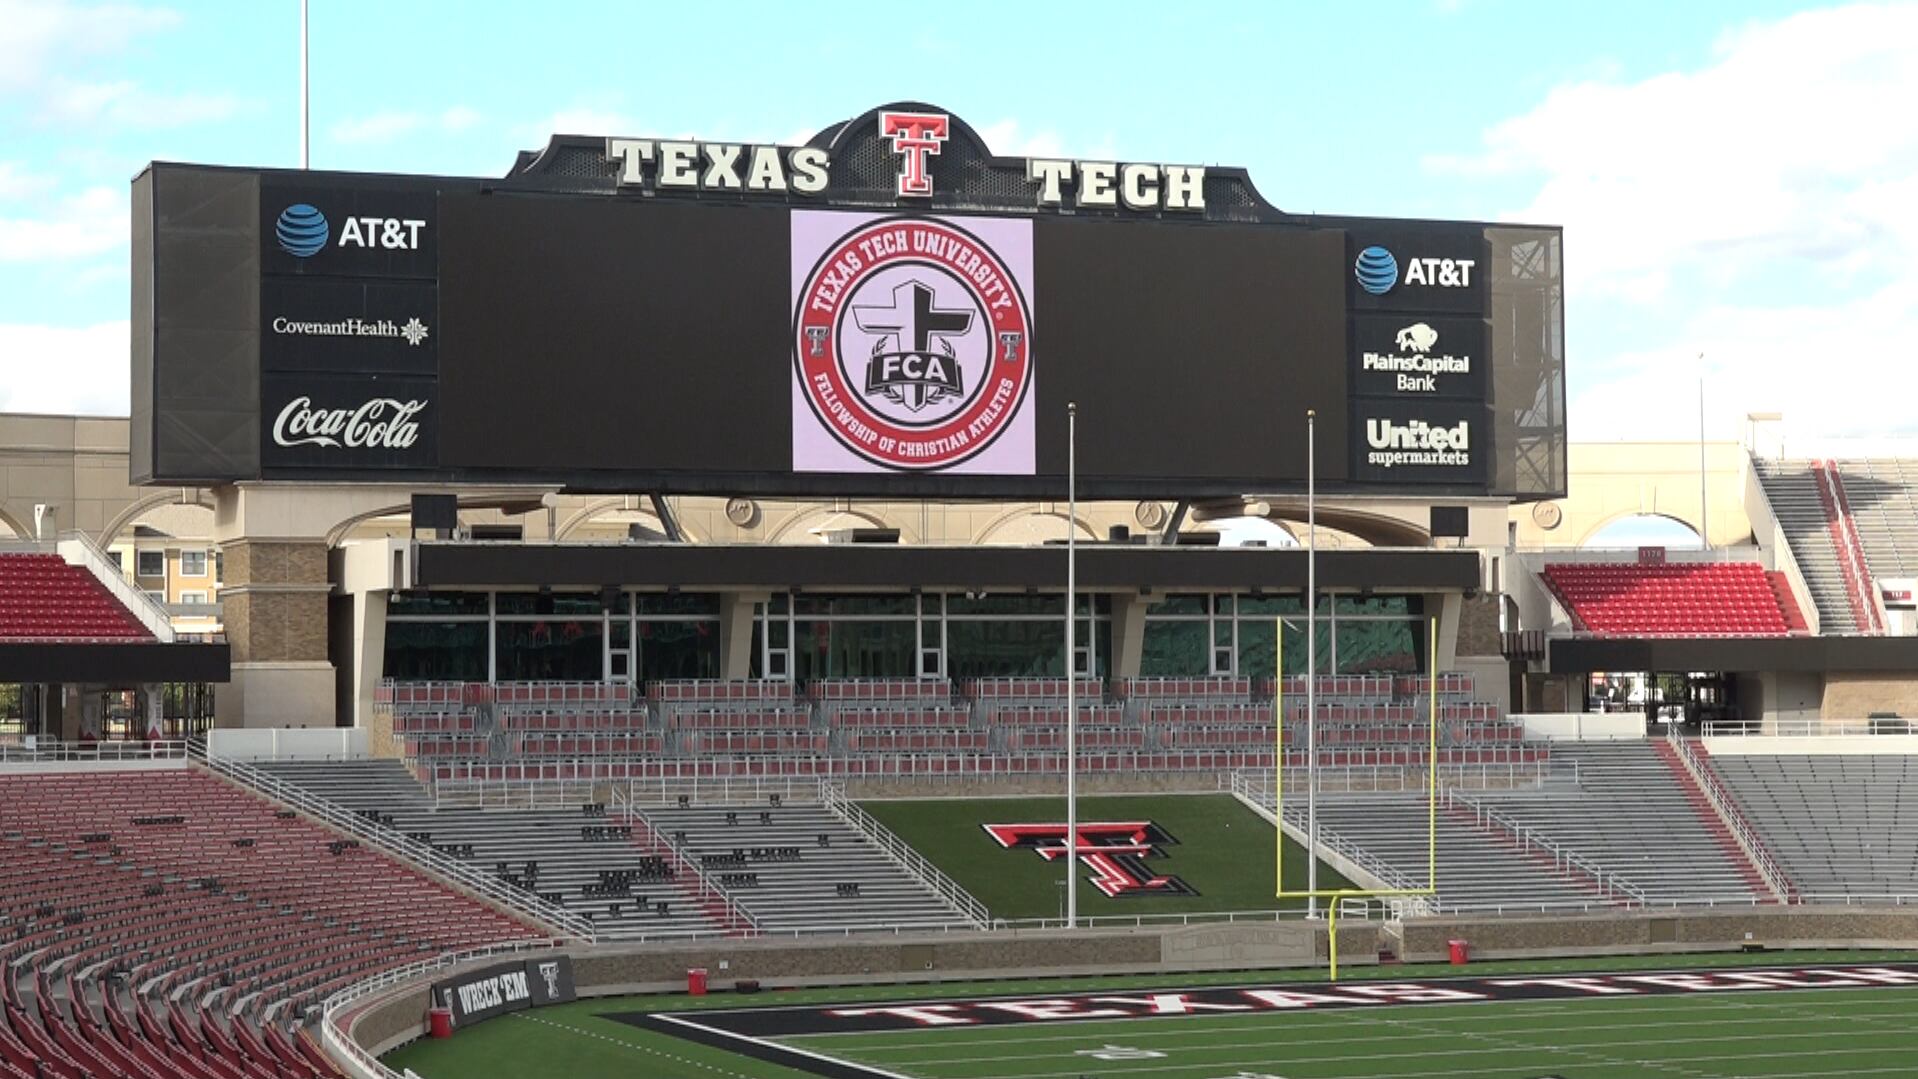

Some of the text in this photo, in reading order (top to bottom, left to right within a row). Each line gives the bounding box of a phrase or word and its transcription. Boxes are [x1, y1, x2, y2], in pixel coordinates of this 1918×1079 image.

[607, 138, 831, 194] TEXAS
[1028, 158, 1206, 209] TECH
[338, 216, 426, 249] AT&T
[812, 229, 1013, 314] TEXAS TECH UNIVERSITY
[1404, 257, 1475, 287] AT&T
[273, 317, 399, 337] CovenantHealth
[881, 354, 948, 383] FCA
[1363, 352, 1470, 374] PlainsCapital
[1397, 373, 1436, 391] Bank
[273, 396, 428, 448] Coca-Cola
[814, 372, 1014, 458] FELLOWSHIP OF CHRISTIAN ATHLETES
[1367, 419, 1468, 450] United
[1368, 449, 1469, 467] supermarkets
[823, 984, 1492, 1026] TEXAS
